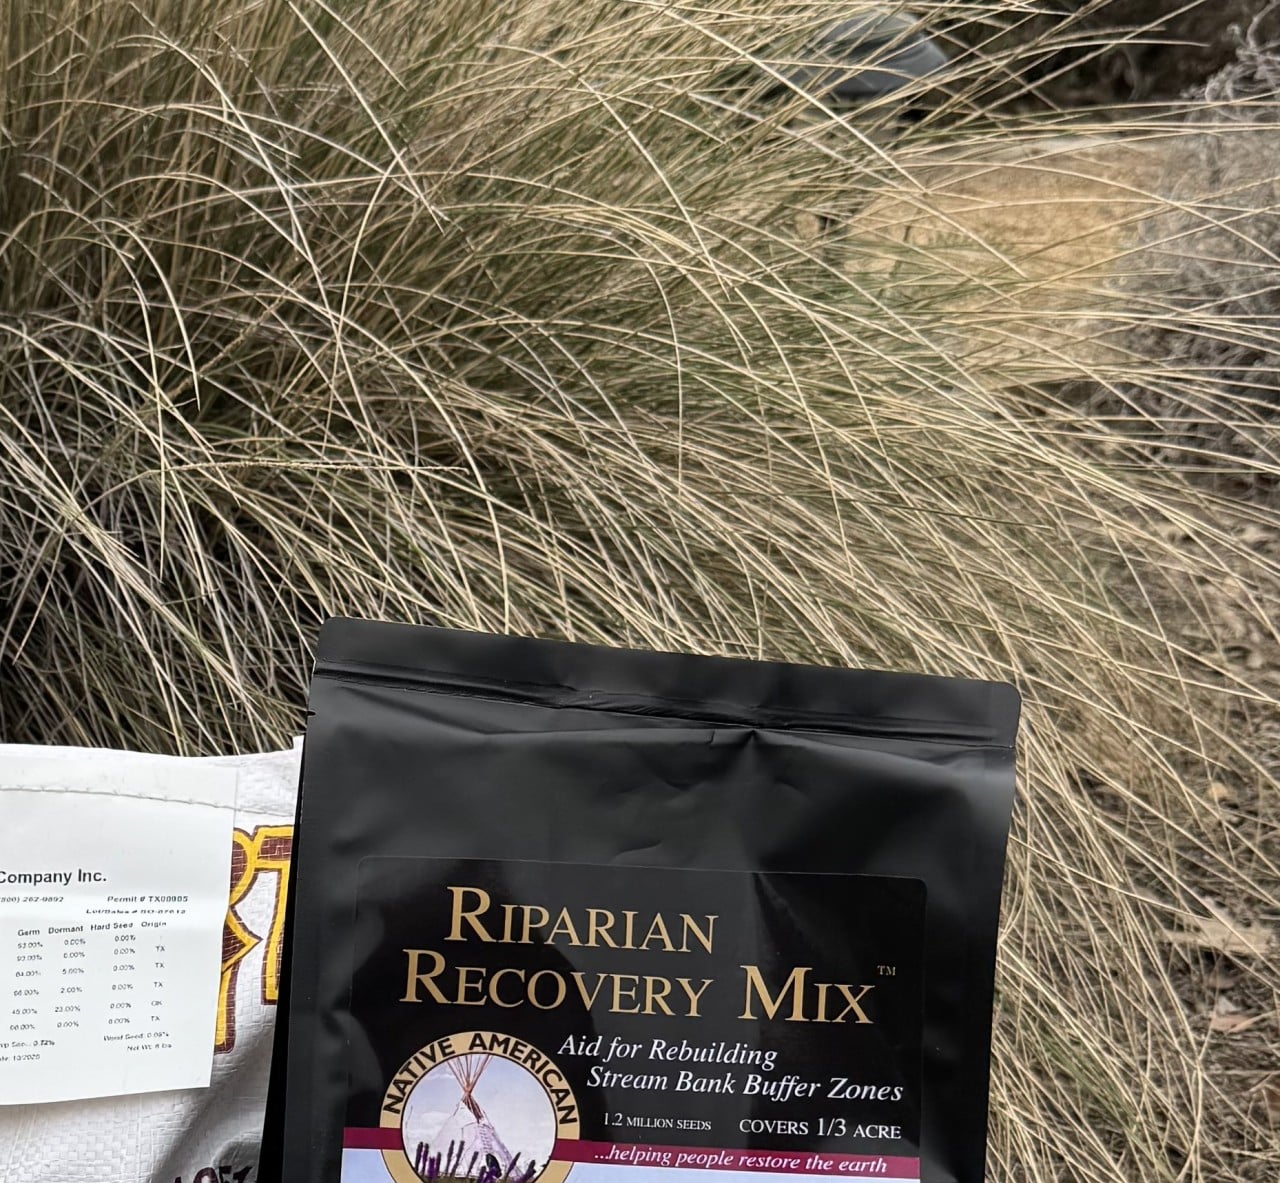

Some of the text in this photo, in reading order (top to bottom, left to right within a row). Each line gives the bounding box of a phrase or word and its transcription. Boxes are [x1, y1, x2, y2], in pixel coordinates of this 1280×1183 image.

[77, 868, 107, 882] Inc.
[107, 895, 137, 903] Permit
[48, 925, 84, 935] Dormant
[90, 922, 111, 931] Hard
[444, 885, 719, 954] RIPARIAN
[17, 929, 40, 937] Germ
[400, 948, 714, 1018] RECOVERY
[737, 964, 876, 1025] MIX
[557, 1034, 778, 1071] Aid for Rebuilding
[382, 1032, 577, 1126] NATIVE AMERICAN
[586, 1066, 904, 1102] Stream Bank Buffer Zones
[603, 1112, 712, 1131] 1.2 MILLION SEEDS
[739, 1117, 902, 1140] COVERS 1/3 ACRE
[675, 1150, 735, 1170] people
[738, 1154, 801, 1171] restore
[805, 1155, 829, 1172] the
[833, 1157, 888, 1174] earth
